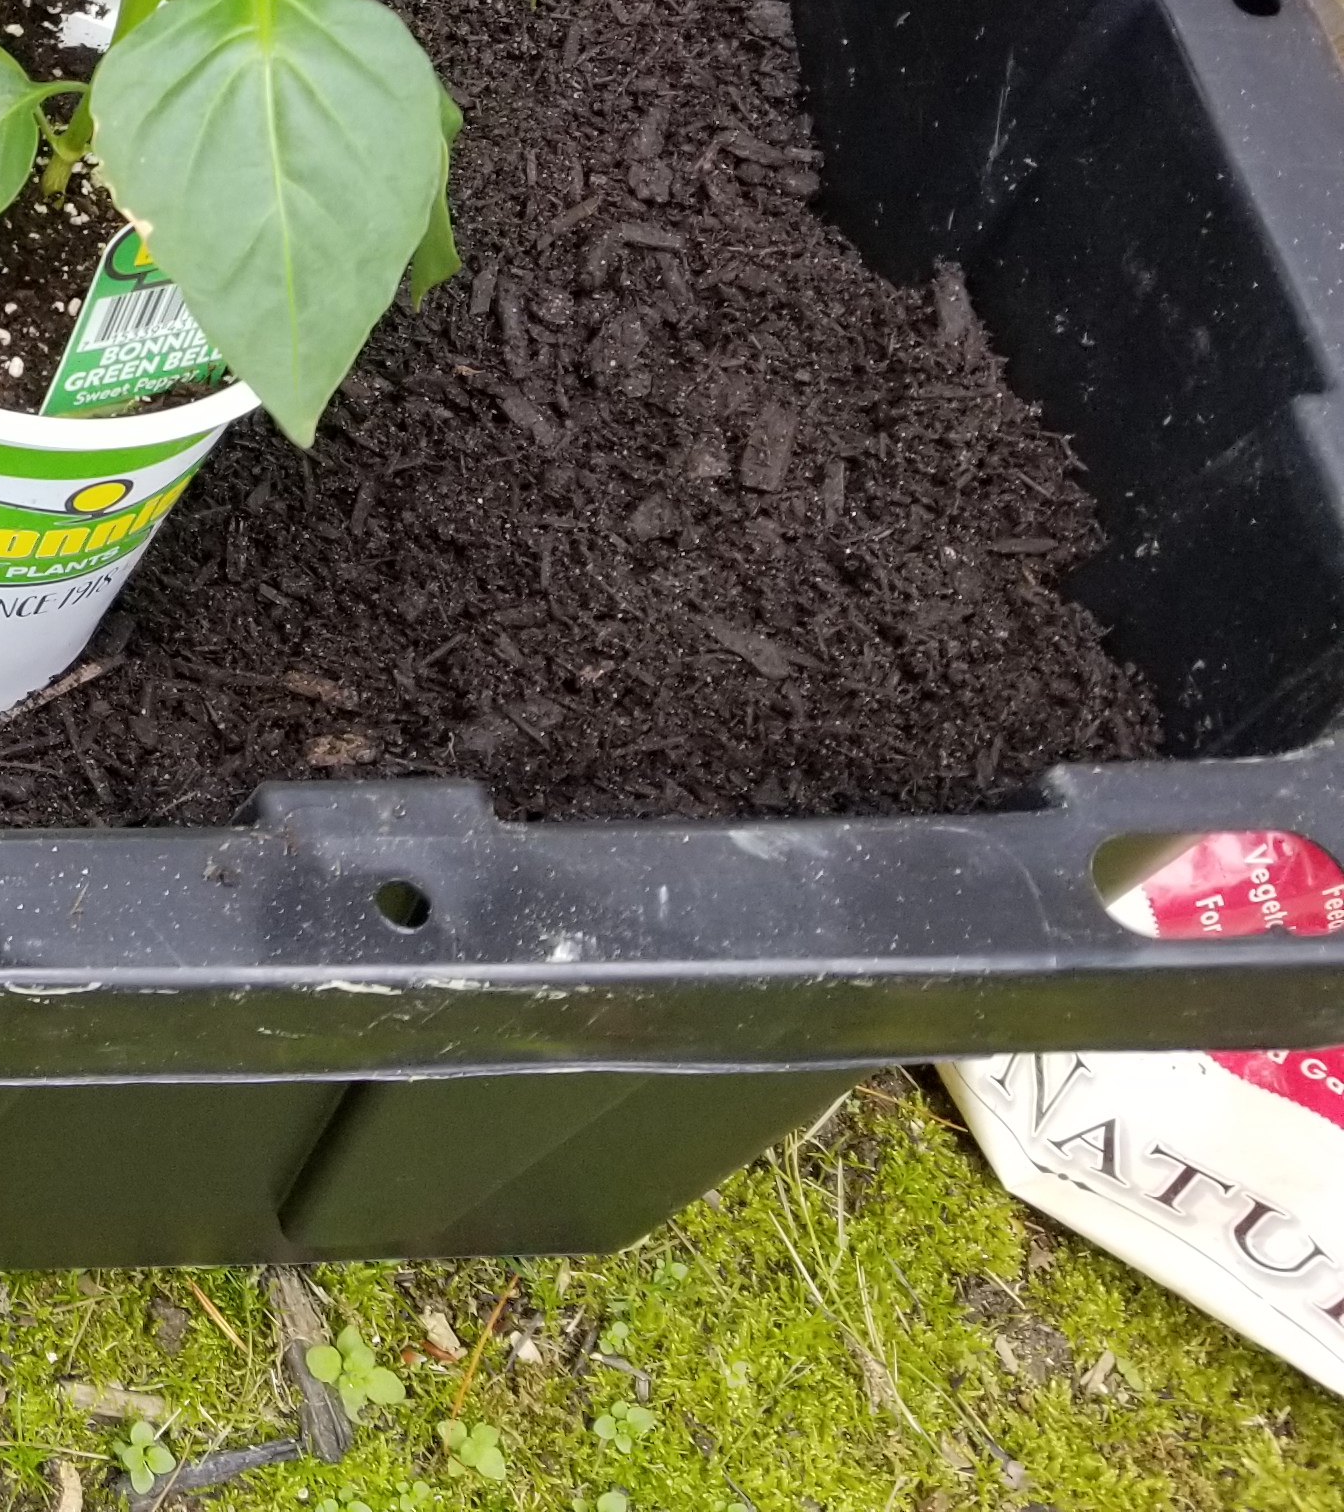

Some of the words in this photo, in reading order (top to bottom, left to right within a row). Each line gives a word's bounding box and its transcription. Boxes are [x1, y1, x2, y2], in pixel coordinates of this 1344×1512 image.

[99, 328, 208, 367] BONNIE
[63, 356, 161, 392] GREEN
[163, 345, 224, 372] BELL
[73, 383, 132, 406] Sweet
[5, 545, 121, 579] PLANTS
[57, 566, 120, 610] 1918
[1195, 894, 1225, 933] For
[989, 1052, 1344, 1328] NATU
